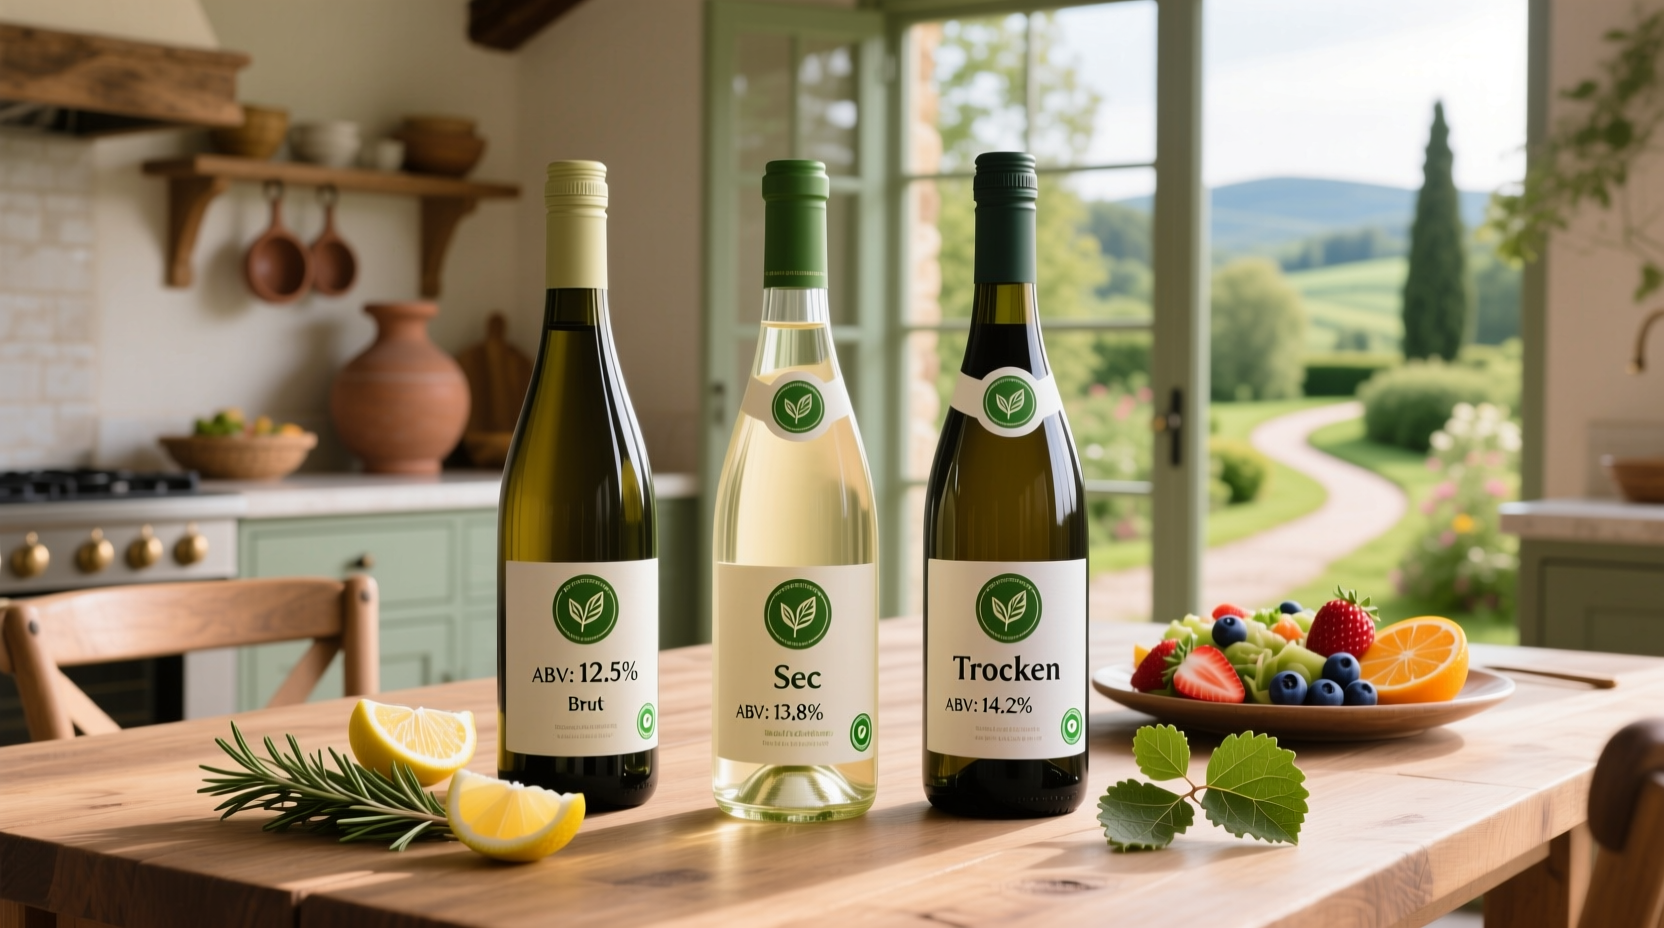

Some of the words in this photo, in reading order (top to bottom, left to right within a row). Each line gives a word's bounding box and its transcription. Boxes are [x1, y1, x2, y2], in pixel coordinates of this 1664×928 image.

[531, 666, 574, 683] ABV:
[579, 660, 638, 683] 12.5%
[773, 664, 822, 690] Sec
[952, 654, 1060, 682] Trocken
[568, 696, 604, 712] Brut
[735, 703, 769, 720] ABV:
[945, 697, 978, 713] ABV:
[982, 696, 1033, 714] 14.2%
